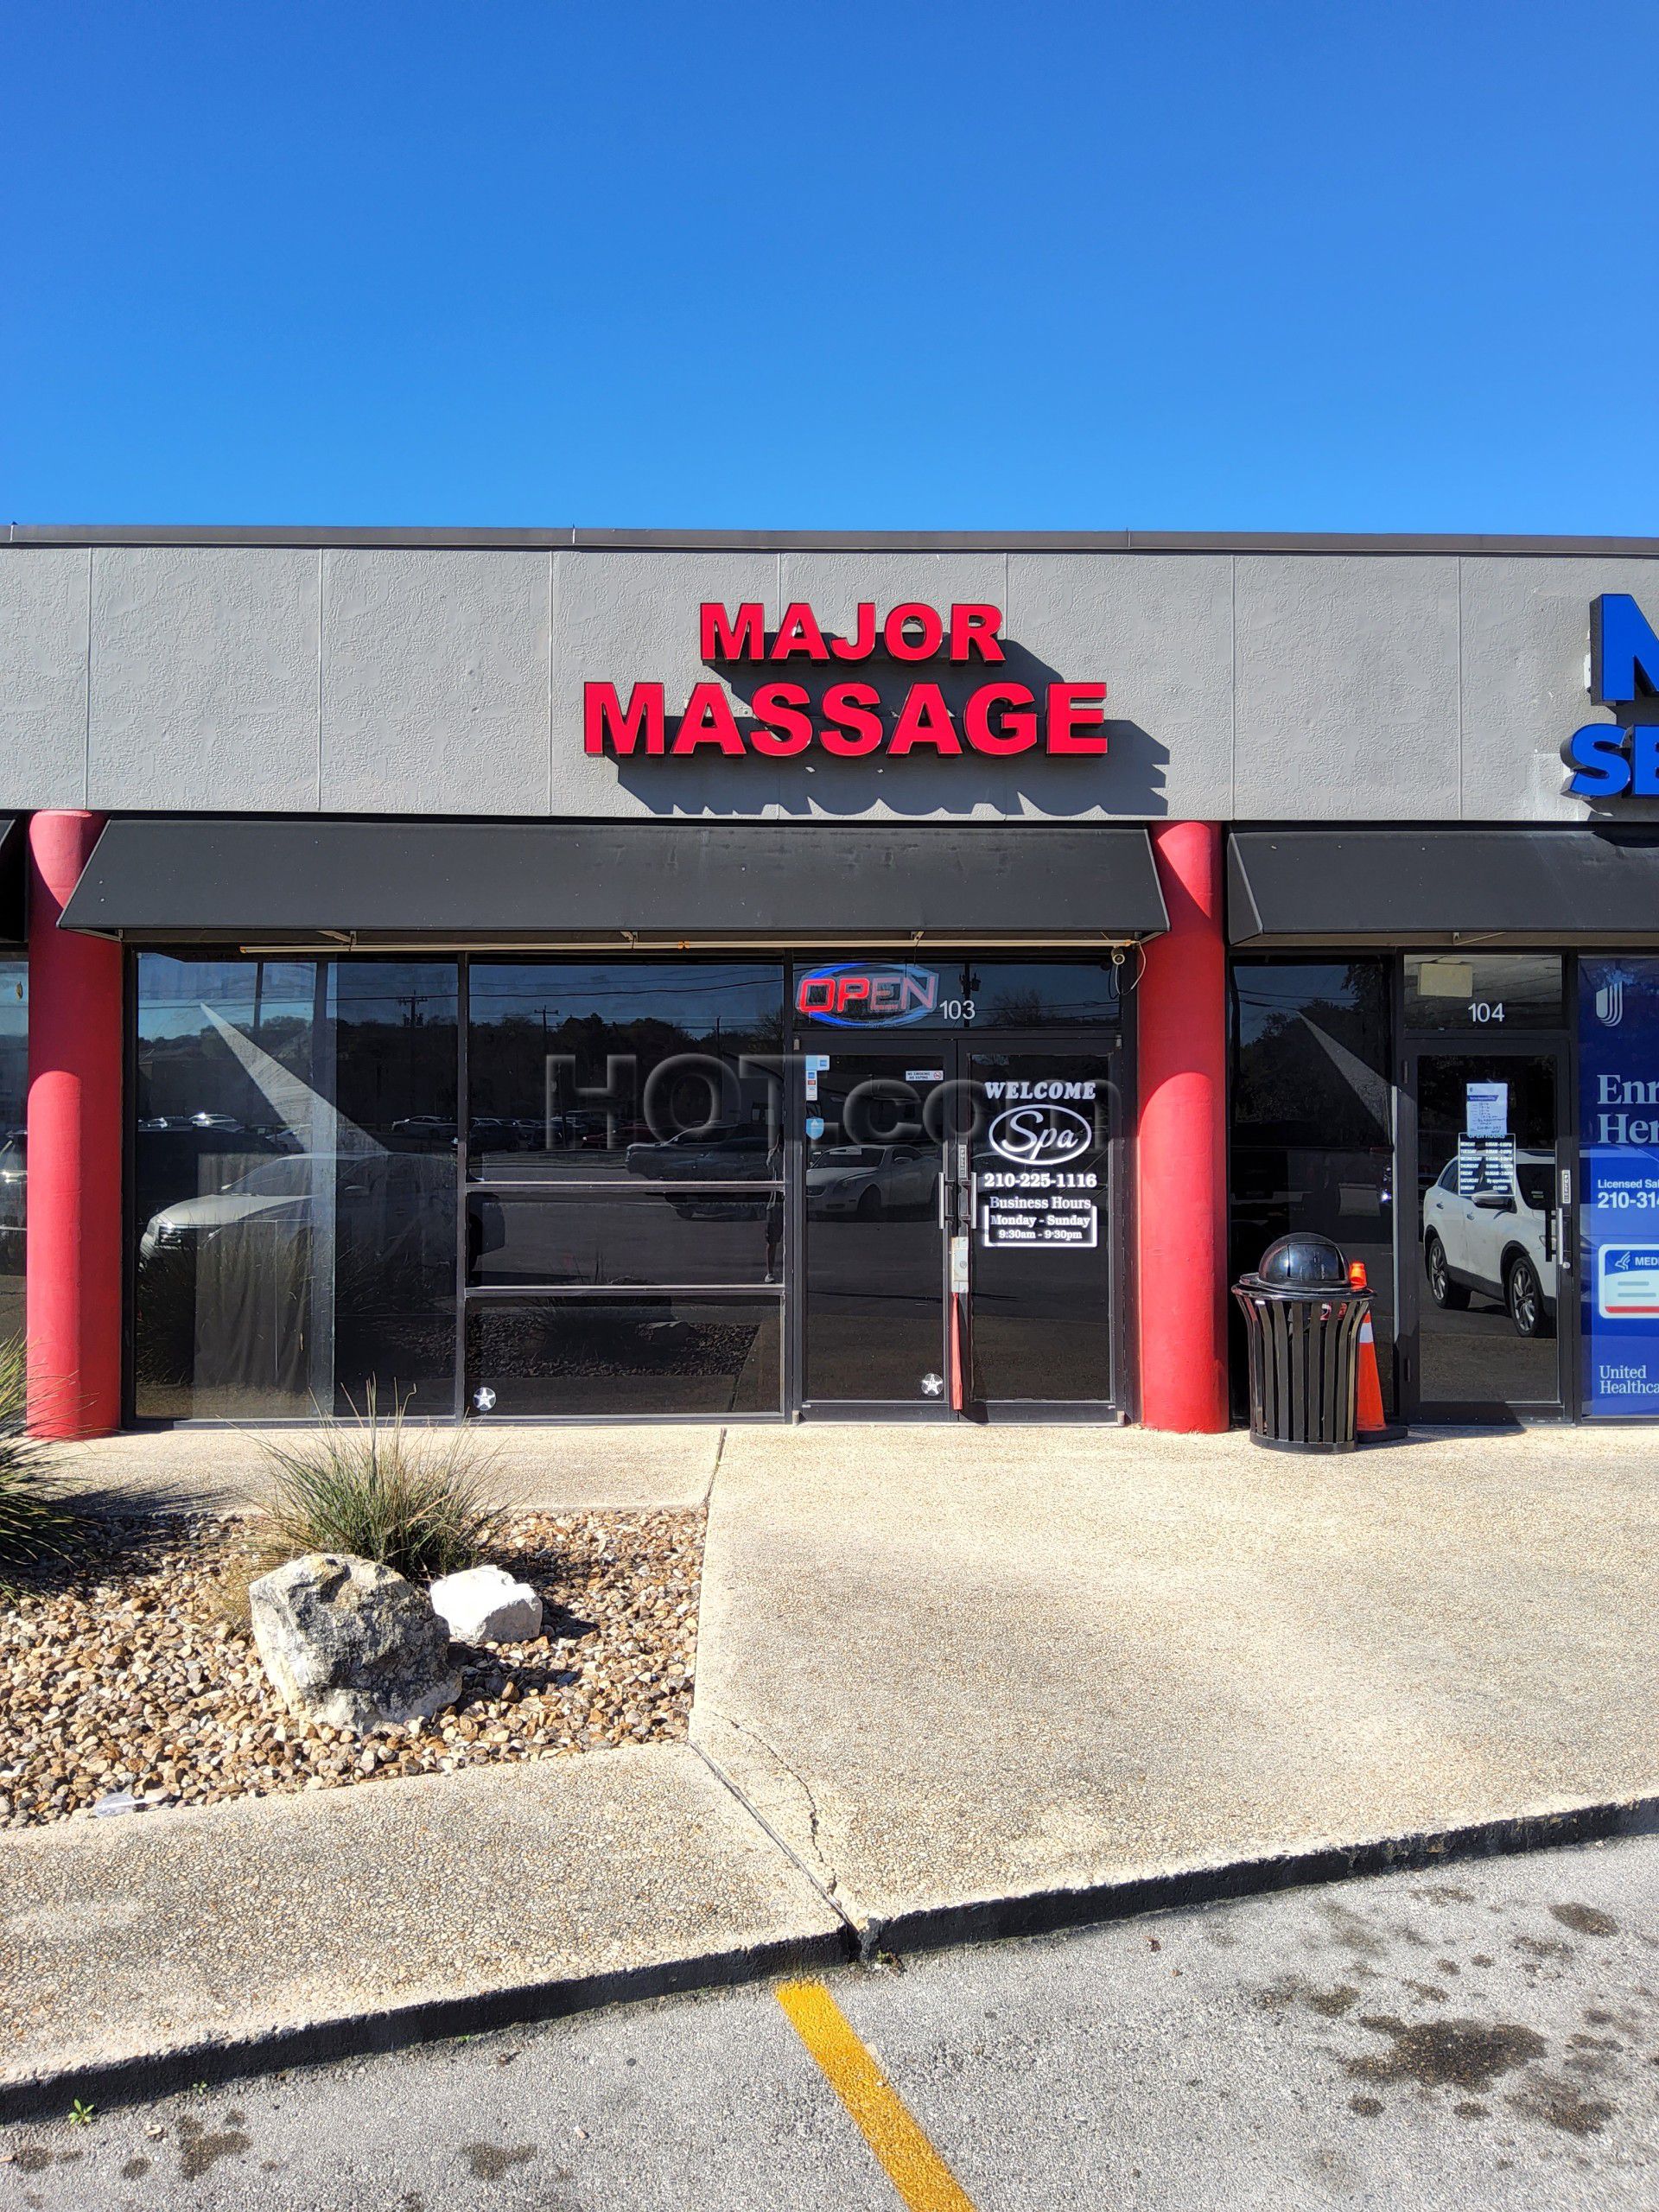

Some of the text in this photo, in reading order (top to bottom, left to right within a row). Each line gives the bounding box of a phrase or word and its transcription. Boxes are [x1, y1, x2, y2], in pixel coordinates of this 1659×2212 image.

[700, 602, 1006, 665] MAJOR
[584, 681, 1109, 758] MASSAGE
[798, 976, 938, 1014] OPEN
[939, 1000, 976, 1020] 103
[1467, 1002, 1505, 1022] 104
[984, 1082, 1096, 1100] WELCOME
[1001, 1110, 1079, 1160] Spa
[984, 1173, 1097, 1188] 210-225-1116
[1598, 1179, 1643, 1189] Licensed
[989, 1196, 1091, 1210] Business Hours
[990, 1214, 1038, 1228] Monday
[1046, 1214, 1091, 1229] Sunday
[998, 1230, 1036, 1239] 9:30am
[1599, 1365, 1647, 1379] United
